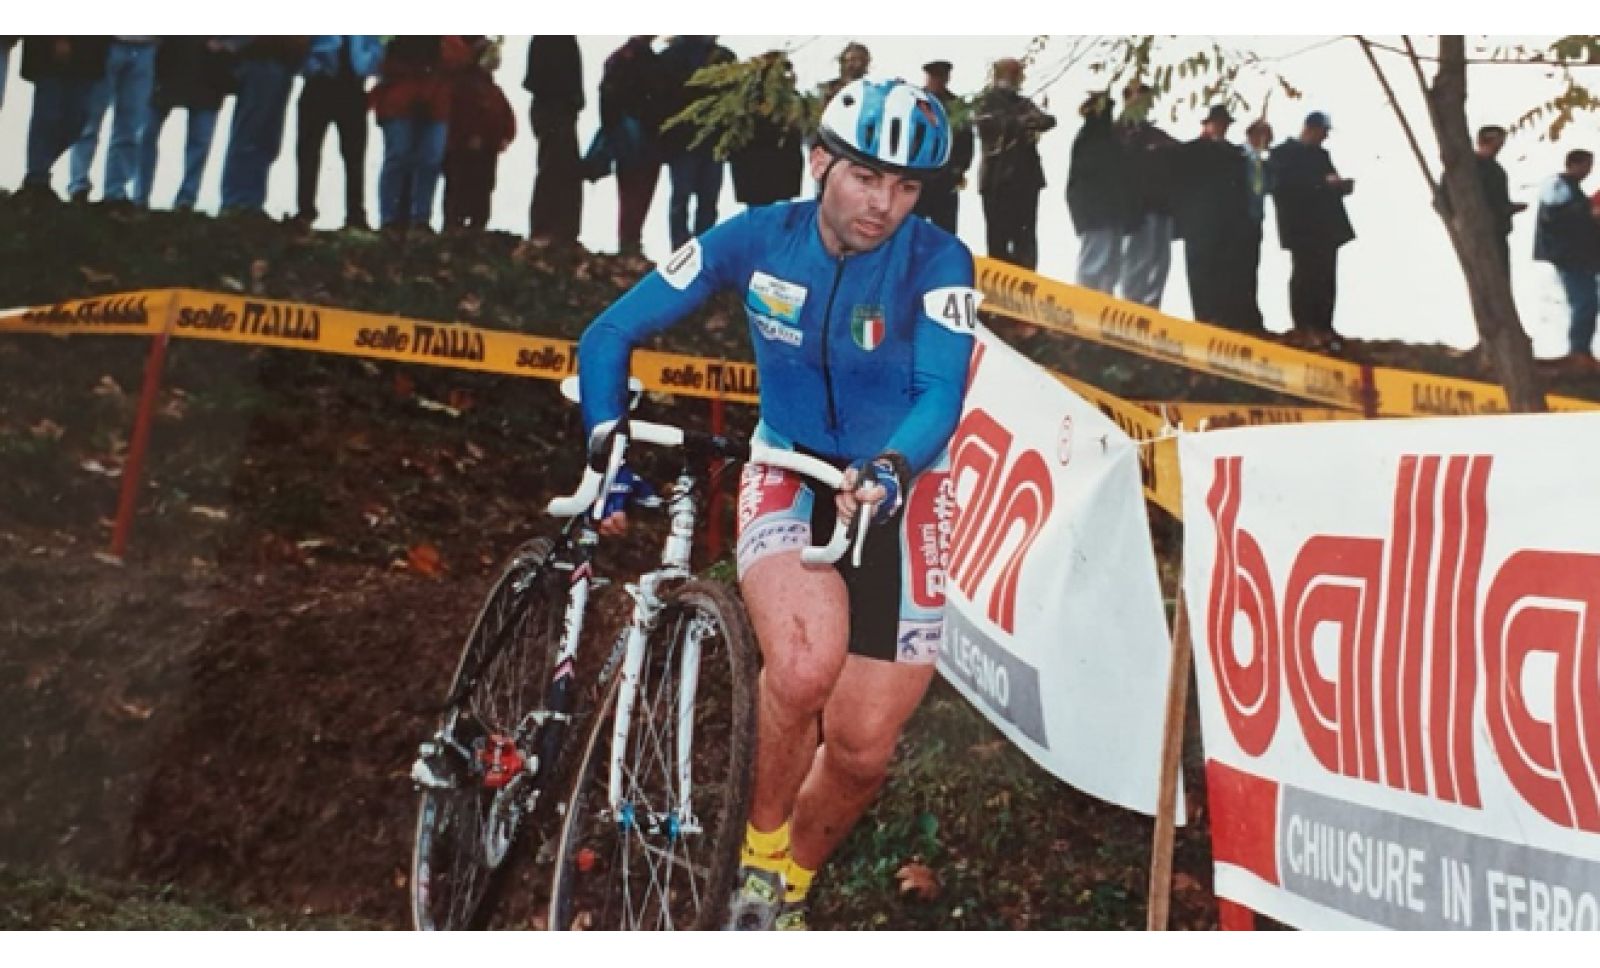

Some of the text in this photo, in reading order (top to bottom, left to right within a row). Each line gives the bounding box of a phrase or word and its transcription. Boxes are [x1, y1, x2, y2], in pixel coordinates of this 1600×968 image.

[176, 301, 320, 341] selle ITALIA
[943, 292, 976, 328] 40
[354, 324, 485, 362] selle ITALIA
[705, 363, 760, 393] ITALI
[1206, 455, 1600, 836] balla
[951, 626, 1010, 708] LEGNO
[1286, 814, 1600, 931] CHIUSURE IN FERRO
